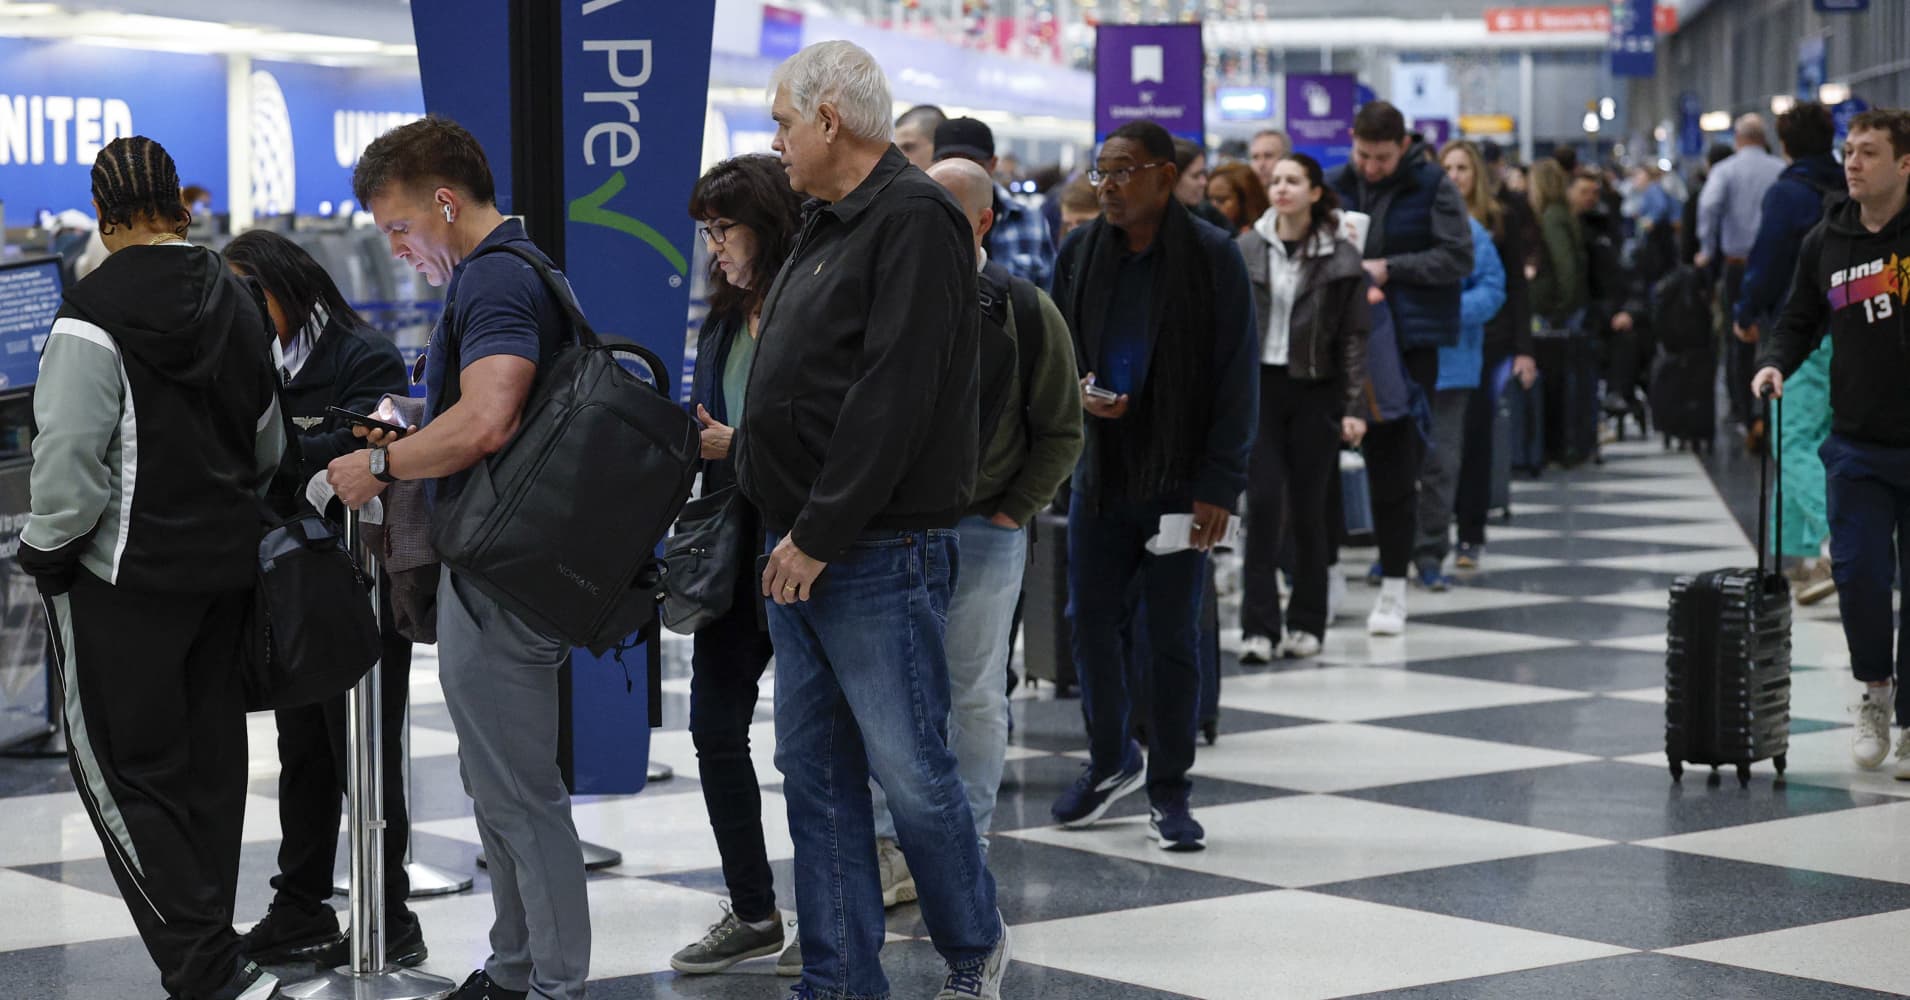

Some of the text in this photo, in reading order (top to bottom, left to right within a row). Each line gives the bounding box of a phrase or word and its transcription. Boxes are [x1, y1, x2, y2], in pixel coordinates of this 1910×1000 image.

[582, 39, 652, 167] Pre
[1864, 293, 1893, 323] 13
[557, 563, 600, 596] NOMATIC
